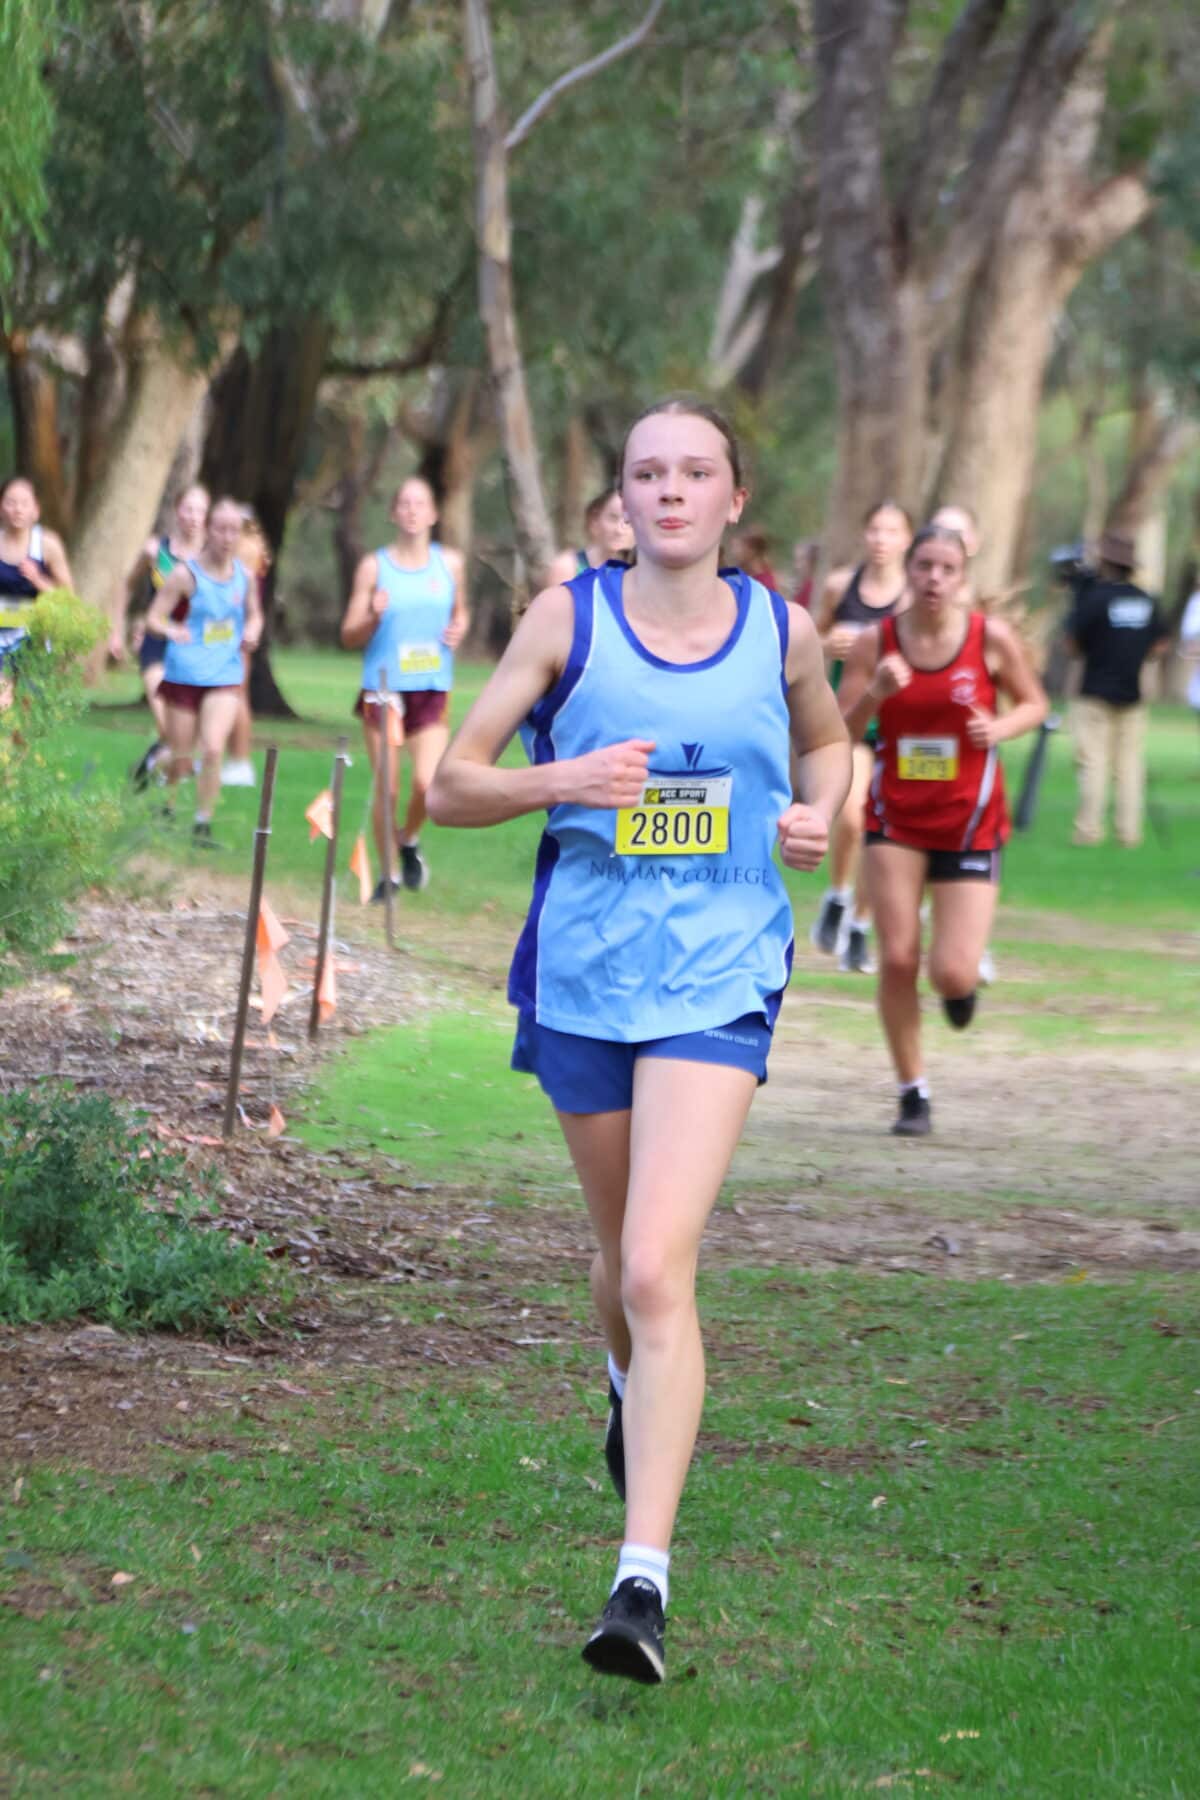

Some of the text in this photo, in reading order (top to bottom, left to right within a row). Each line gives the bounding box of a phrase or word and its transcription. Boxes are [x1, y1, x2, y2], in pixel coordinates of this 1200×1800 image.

[660, 789, 706, 798] ACC SPORT
[631, 811, 713, 845] 2800
[683, 865, 769, 886] COLLEGE
